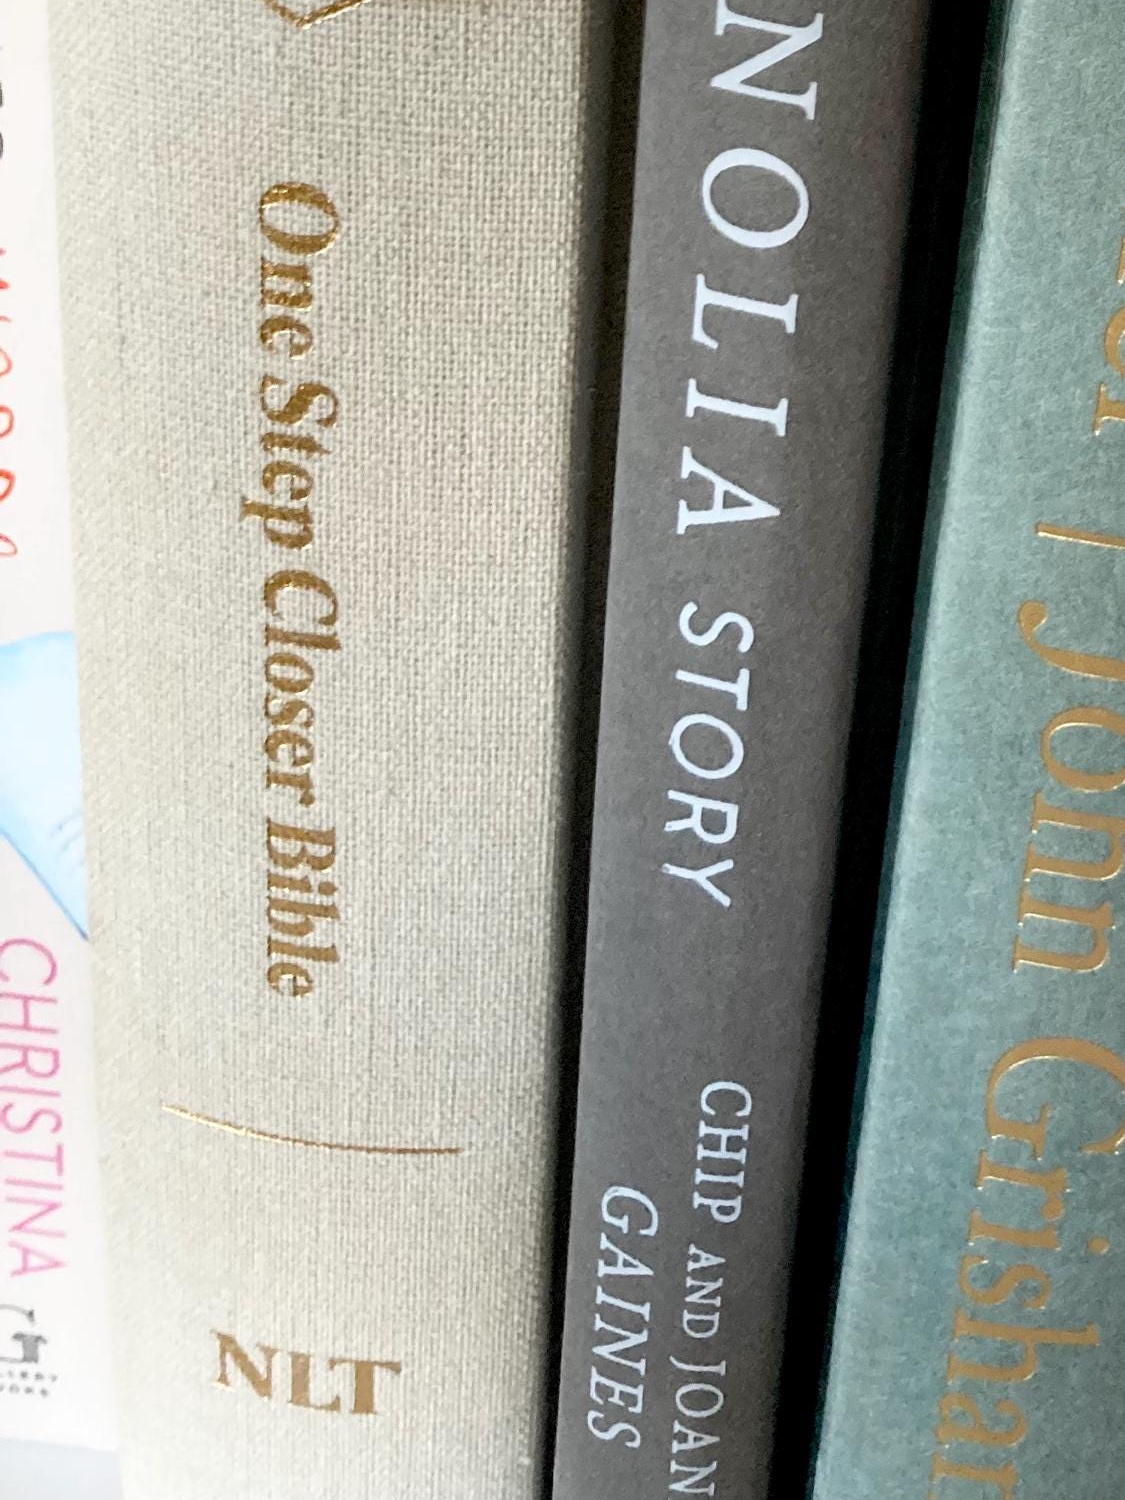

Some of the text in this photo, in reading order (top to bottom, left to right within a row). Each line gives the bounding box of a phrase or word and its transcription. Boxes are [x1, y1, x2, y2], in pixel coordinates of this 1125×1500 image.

[240, 180, 342, 999] One Step Closer Bible
[660, 600, 755, 909] STORY
[0, 937, 67, 1278] CHRISTINA
[209, 1328, 402, 1415] NLT
[587, 1184, 660, 1450] GAINES
[668, 1080, 753, 1500] CHIP AND JOAN
